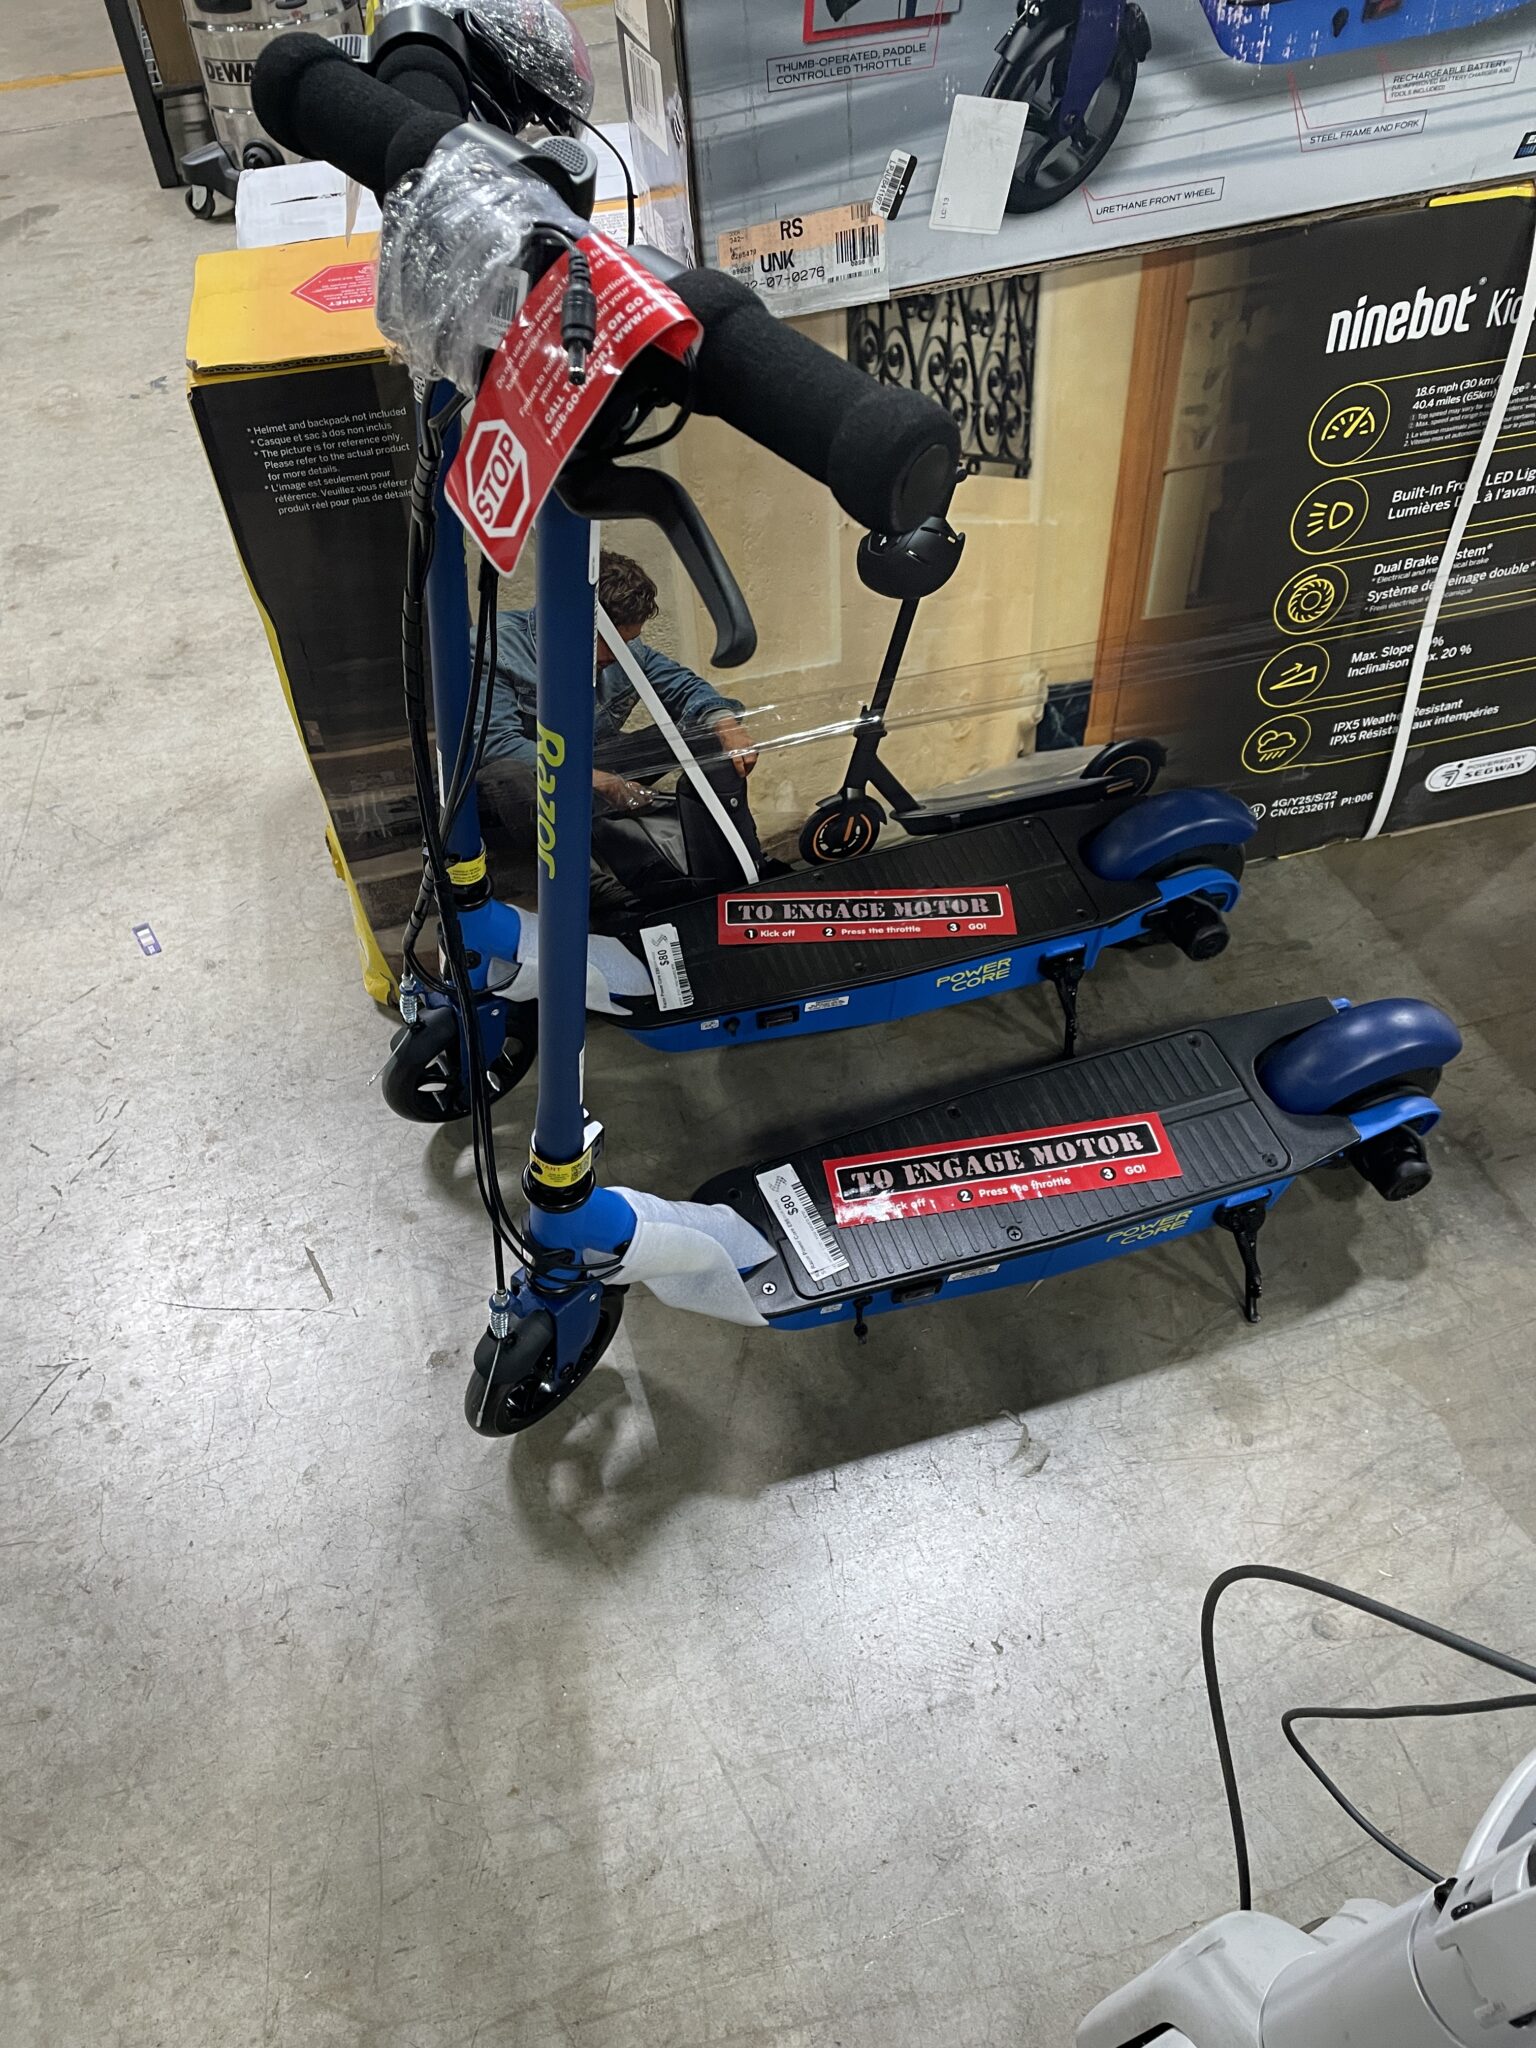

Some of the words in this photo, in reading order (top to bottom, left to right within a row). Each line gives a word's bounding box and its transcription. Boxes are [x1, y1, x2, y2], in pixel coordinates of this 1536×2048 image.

[776, 50, 881, 73] THUMB-OPERATED,
[882, 43, 927, 57] PADDLE
[776, 66, 850, 84] CONTROLLED
[854, 56, 912, 73] THROTTLE
[204, 60, 252, 82] DEWA
[1393, 66, 1467, 84] RECHARGEABLE
[1468, 60, 1508, 72] BATTERY
[1310, 133, 1338, 145] STEEL
[1340, 127, 1372, 139] FRAME
[1373, 123, 1393, 134] AND
[1394, 120, 1420, 130] FORK
[1096, 200, 1148, 216] URETHANE
[1149, 194, 1183, 207] FRONT
[1184, 188, 1216, 199] WHEEL
[780, 217, 804, 241] RS
[760, 248, 795, 273] UNK
[1325, 286, 1477, 354] ninebot
[496, 374, 506, 390] Do
[512, 340, 524, 359] use
[534, 284, 563, 322] product
[518, 329, 543, 369] charged
[541, 314, 555, 329] the
[540, 381, 554, 404] your
[609, 286, 631, 307] your
[545, 395, 566, 424] CALL
[608, 312, 626, 331] OR
[625, 297, 644, 314] GO
[518, 385, 539, 418] Failure
[536, 374, 546, 385] to
[1415, 385, 1436, 398] 18.6
[1436, 382, 1459, 396] mph
[1460, 378, 1477, 391] (30
[1479, 374, 1502, 387] km/
[1412, 398, 1435, 410] 40.4
[1435, 395, 1461, 407] miles
[1462, 388, 1497, 404] (65km)
[254, 424, 287, 436] Helmet
[289, 421, 306, 430] and
[307, 414, 351, 428] backpack
[352, 412, 367, 422] not
[368, 406, 407, 420] included
[257, 435, 292, 448] Casque
[293, 434, 303, 442] et
[304, 432, 320, 442] sac
[322, 430, 328, 439] à
[329, 427, 346, 437] dos
[346, 426, 365, 435] non
[366, 422, 393, 433] inclus
[260, 450, 279, 459] The
[280, 444, 312, 458] picture
[314, 444, 321, 452] is
[322, 440, 337, 450] for
[338, 435, 380, 449] reference
[264, 460, 295, 470] Please
[296, 457, 318, 466] refer
[319, 454, 329, 462] to
[330, 452, 346, 461] the
[347, 448, 374, 459] actual
[376, 442, 410, 457] product
[268, 472, 281, 481] for
[283, 470, 307, 480] more
[270, 480, 306, 493] L'image
[308, 478, 323, 488] est
[324, 472, 370, 486] seulement
[370, 470, 391, 481] pour
[476, 432, 515, 525] STOP
[1392, 484, 1443, 503] Built-In
[1486, 470, 1514, 486] LED
[1516, 467, 1536, 481] Lig
[274, 492, 320, 504] référence.
[320, 486, 355, 497] Veuillez
[356, 484, 378, 493] vous
[378, 479, 408, 489] référer
[278, 504, 311, 516] produit
[312, 500, 329, 510] réel
[330, 498, 351, 510] pour
[352, 494, 371, 505] plus
[372, 493, 384, 501] de
[1388, 500, 1452, 520] Lumières
[1484, 490, 1493, 503] à
[1374, 561, 1402, 576] Dual
[1404, 554, 1439, 570] Brake
[1377, 570, 1412, 584] Electrical
[1411, 568, 1426, 578] and
[1468, 556, 1490, 567] brake
[1368, 584, 1419, 604] Système
[1421, 580, 1436, 592] de
[1348, 658, 1410, 678] Inclinaison
[1440, 646, 1458, 660] 20
[1460, 644, 1473, 656] %
[1351, 652, 1379, 664] Max.
[1381, 644, 1415, 658] Slope
[1330, 732, 1357, 747] IPX5
[1412, 718, 1432, 730] aux
[1434, 705, 1500, 725] intempéries
[1334, 718, 1361, 734] IPX5
[1414, 698, 1464, 717] Resistant
[1464, 761, 1526, 779] SEGWAY
[536, 720, 566, 880] Razor
[1270, 800, 1335, 818] CN/C232611
[1272, 790, 1339, 808] 4G/Y25/S/22
[738, 904, 773, 921] TO
[782, 902, 886, 920] ENGAGE
[892, 898, 990, 917] MOTOR
[760, 930, 780, 938] Kick
[782, 929, 796, 937] off
[841, 928, 867, 936] Press
[868, 926, 885, 935] the
[886, 925, 921, 934] throttle
[968, 923, 987, 931] GO!
[658, 950, 670, 967] $80
[936, 958, 1012, 988] POWER
[952, 968, 1011, 992] CORE
[851, 1168, 894, 1190] TO
[902, 1150, 1025, 1186] ENGAGE
[1029, 1132, 1144, 1167] MOTOR
[911, 1198, 927, 1209] off
[978, 1187, 1009, 1198] Press
[1031, 1177, 1072, 1190] throttle
[1124, 1164, 1147, 1176] GO!
[780, 1195, 799, 1216] $80
[790, 1228, 799, 1240] Core
[1106, 1210, 1193, 1243] POWER
[1120, 1219, 1189, 1245] CORE
[797, 1240, 808, 1256] Power
